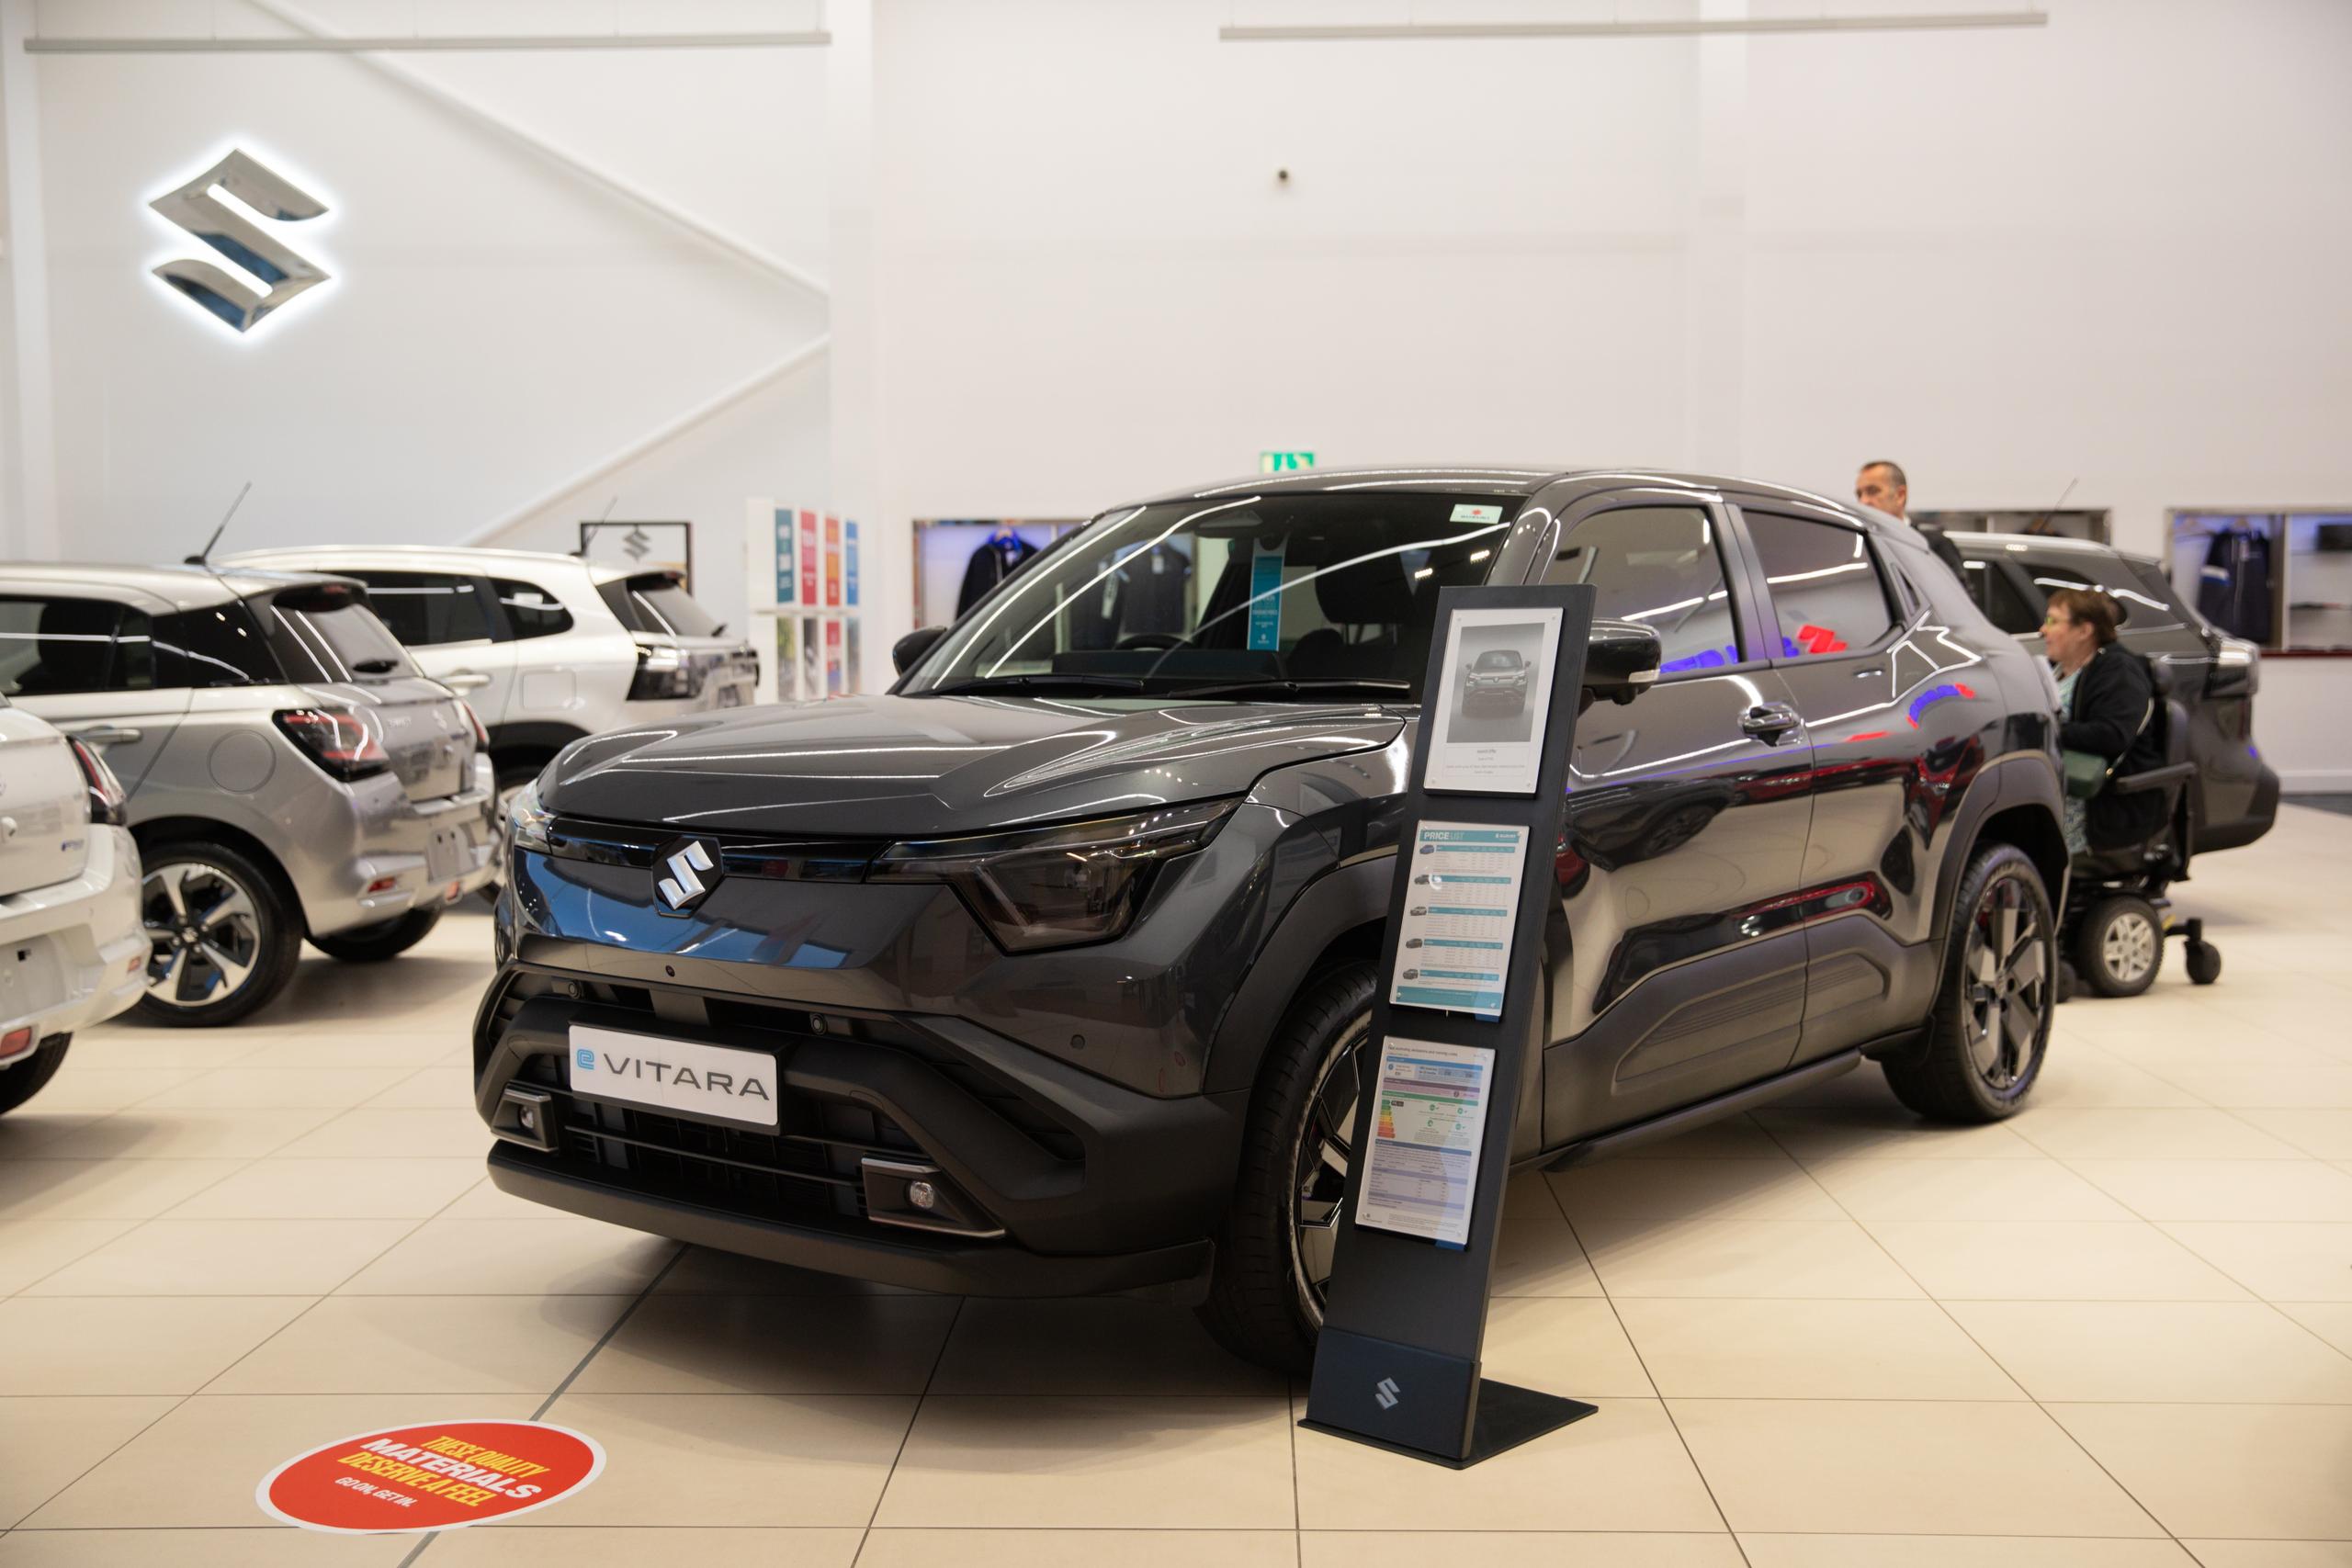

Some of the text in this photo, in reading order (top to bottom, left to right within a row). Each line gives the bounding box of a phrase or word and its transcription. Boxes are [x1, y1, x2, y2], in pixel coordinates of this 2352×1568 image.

[1424, 831, 1450, 840] PRICE
[604, 1054, 770, 1101] VITARA
[337, 1451, 498, 1506] DESERVE A FEEL
[359, 1438, 542, 1498] MATERIALS
[421, 1436, 550, 1478] THESE QUALITY
[334, 1477, 360, 1487] GO
[372, 1489, 404, 1501] GET
